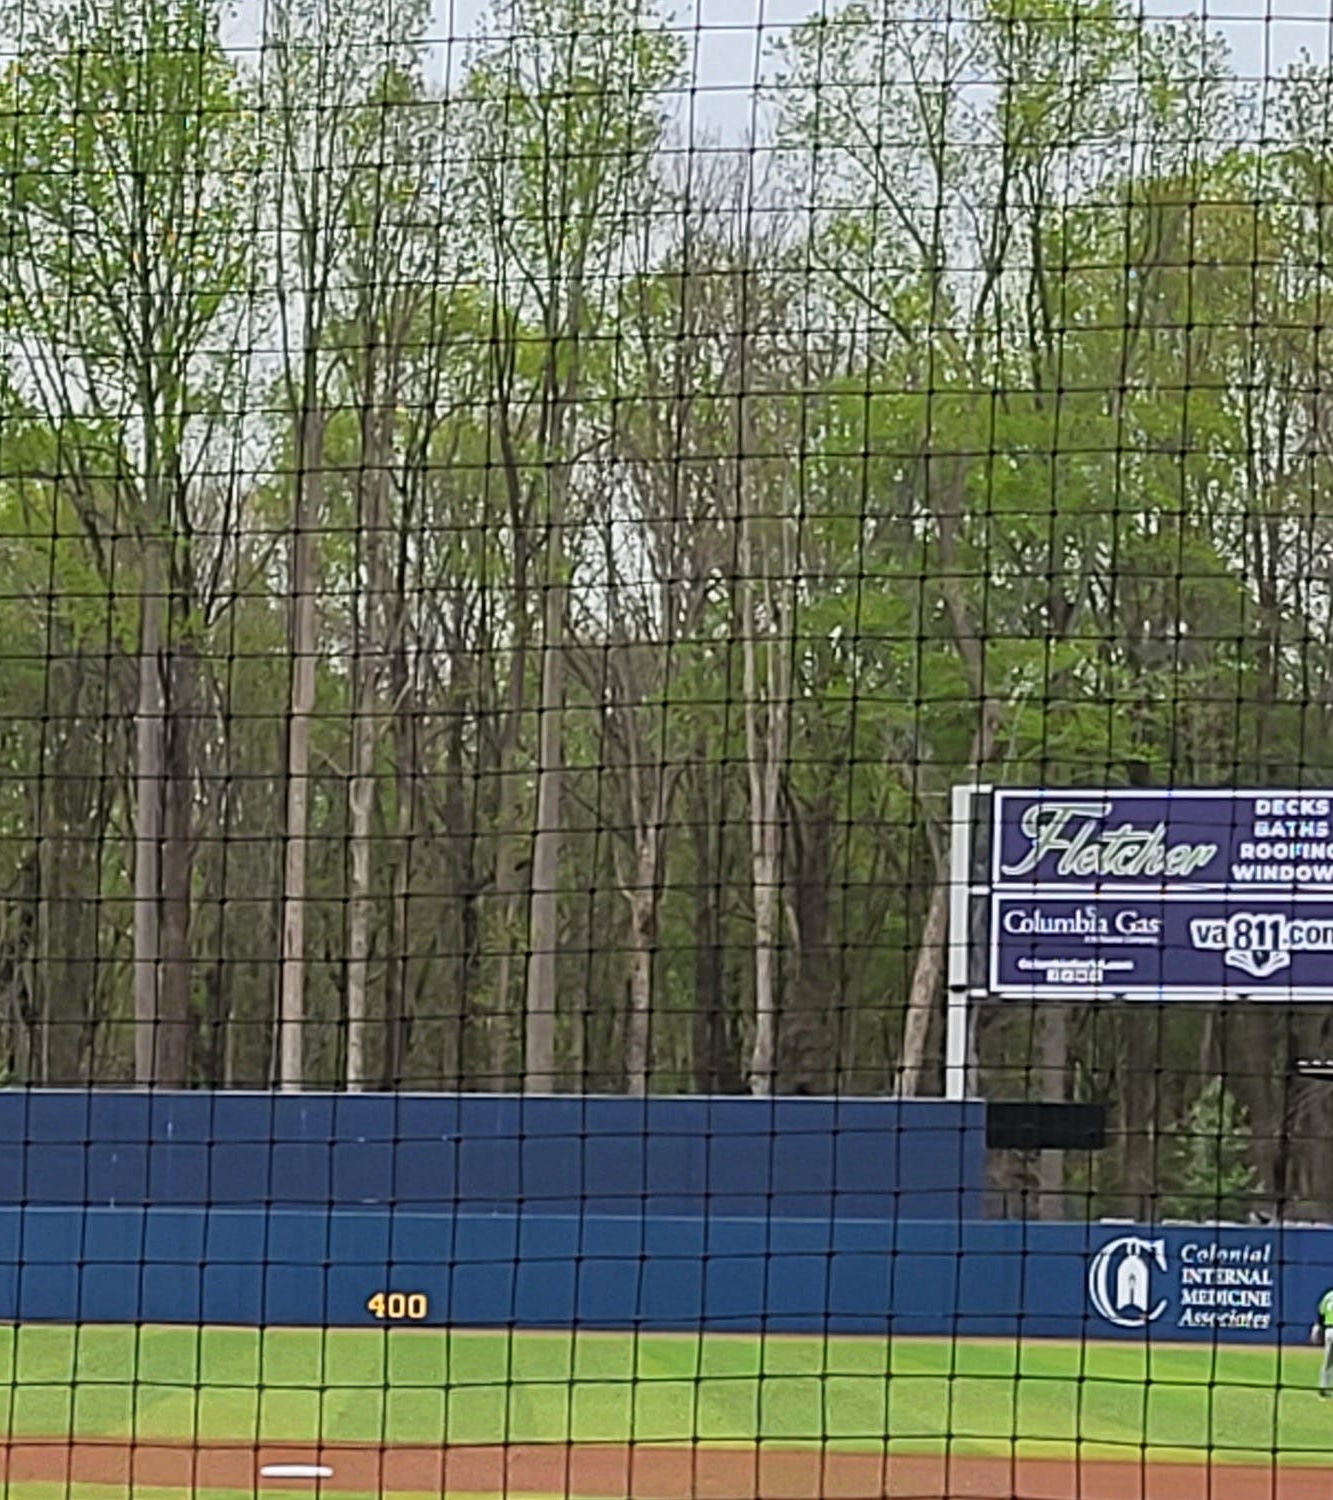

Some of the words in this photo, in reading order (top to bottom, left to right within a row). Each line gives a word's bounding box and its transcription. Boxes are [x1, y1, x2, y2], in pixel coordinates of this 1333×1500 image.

[1255, 799, 1330, 816] DECKS
[1001, 803, 1218, 876] Fletcher
[1254, 820, 1330, 838] BATHS
[1003, 906, 1109, 935] Columbia
[1115, 910, 1162, 935] Gas
[1181, 1243, 1272, 1264] Colonial
[1181, 1267, 1273, 1286] INTERNAL
[367, 1291, 428, 1320] 400
[1180, 1288, 1272, 1308] MEDICINE
[1179, 1307, 1271, 1329] Associates
